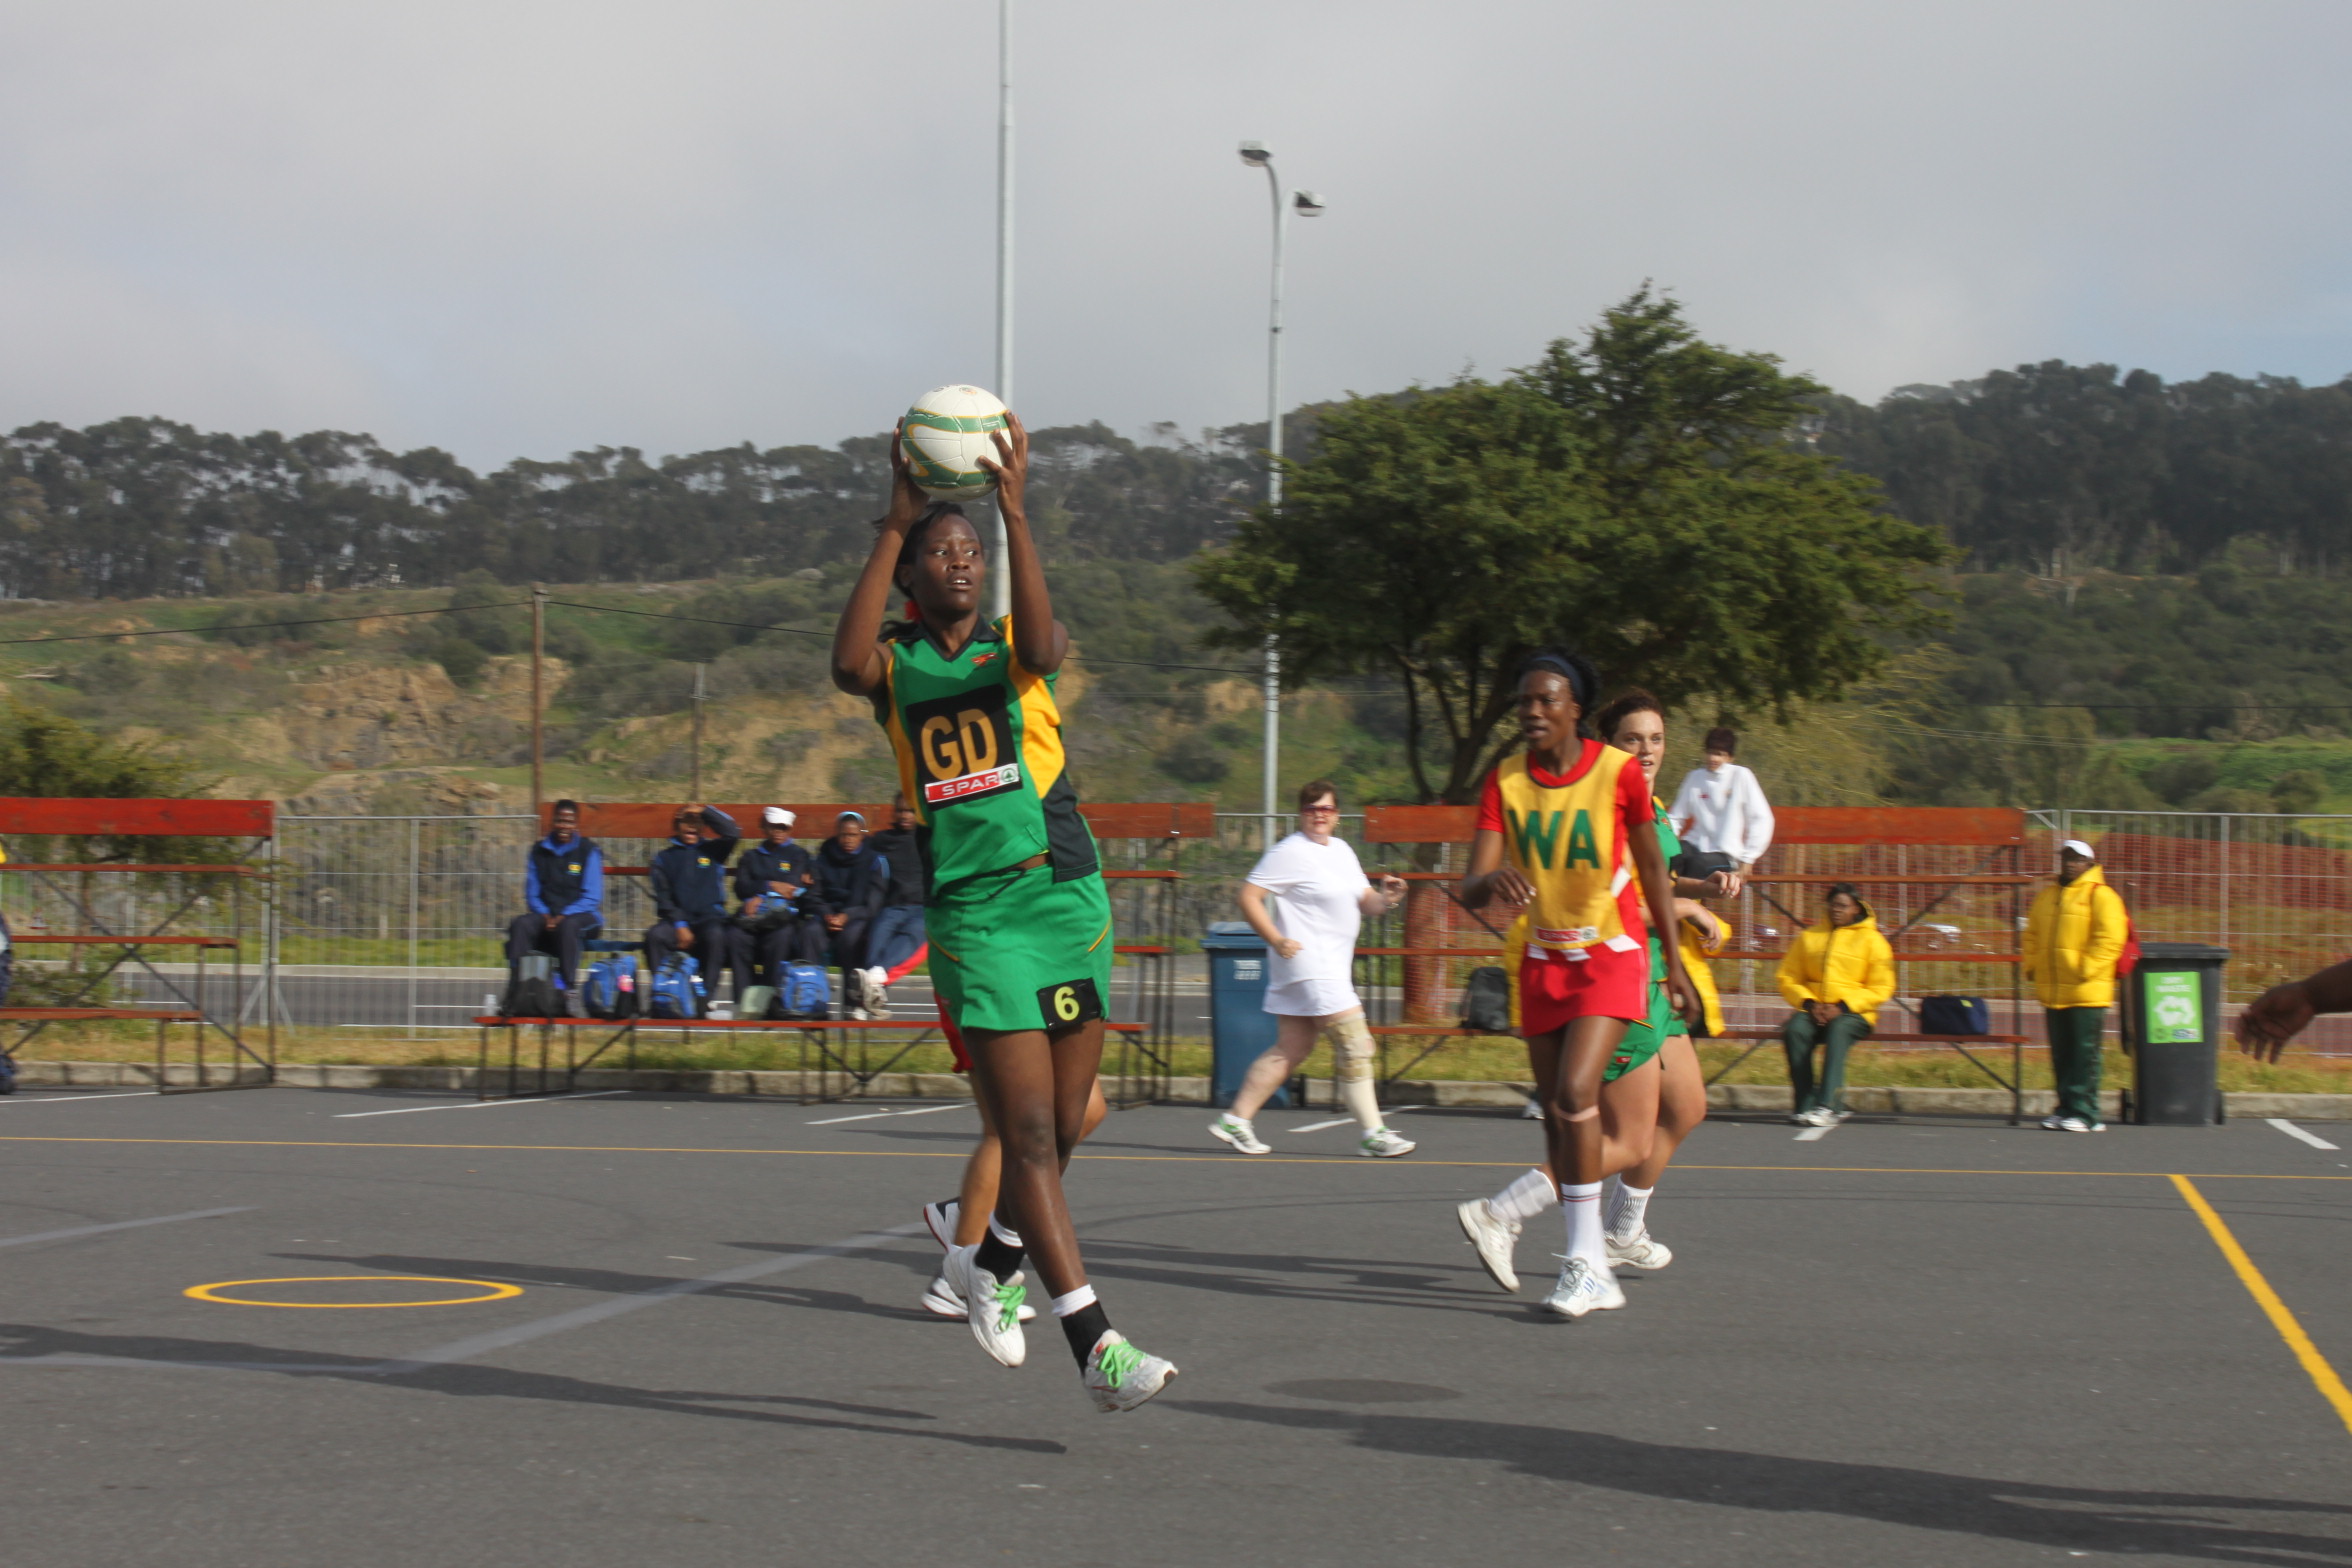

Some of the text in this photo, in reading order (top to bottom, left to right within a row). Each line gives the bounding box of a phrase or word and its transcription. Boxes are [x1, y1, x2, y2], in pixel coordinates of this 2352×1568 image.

[921, 708, 998, 781] GD
[941, 774, 1000, 796] SPAR
[1507, 809, 1600, 869] WA
[1054, 986, 1080, 1021] 6
